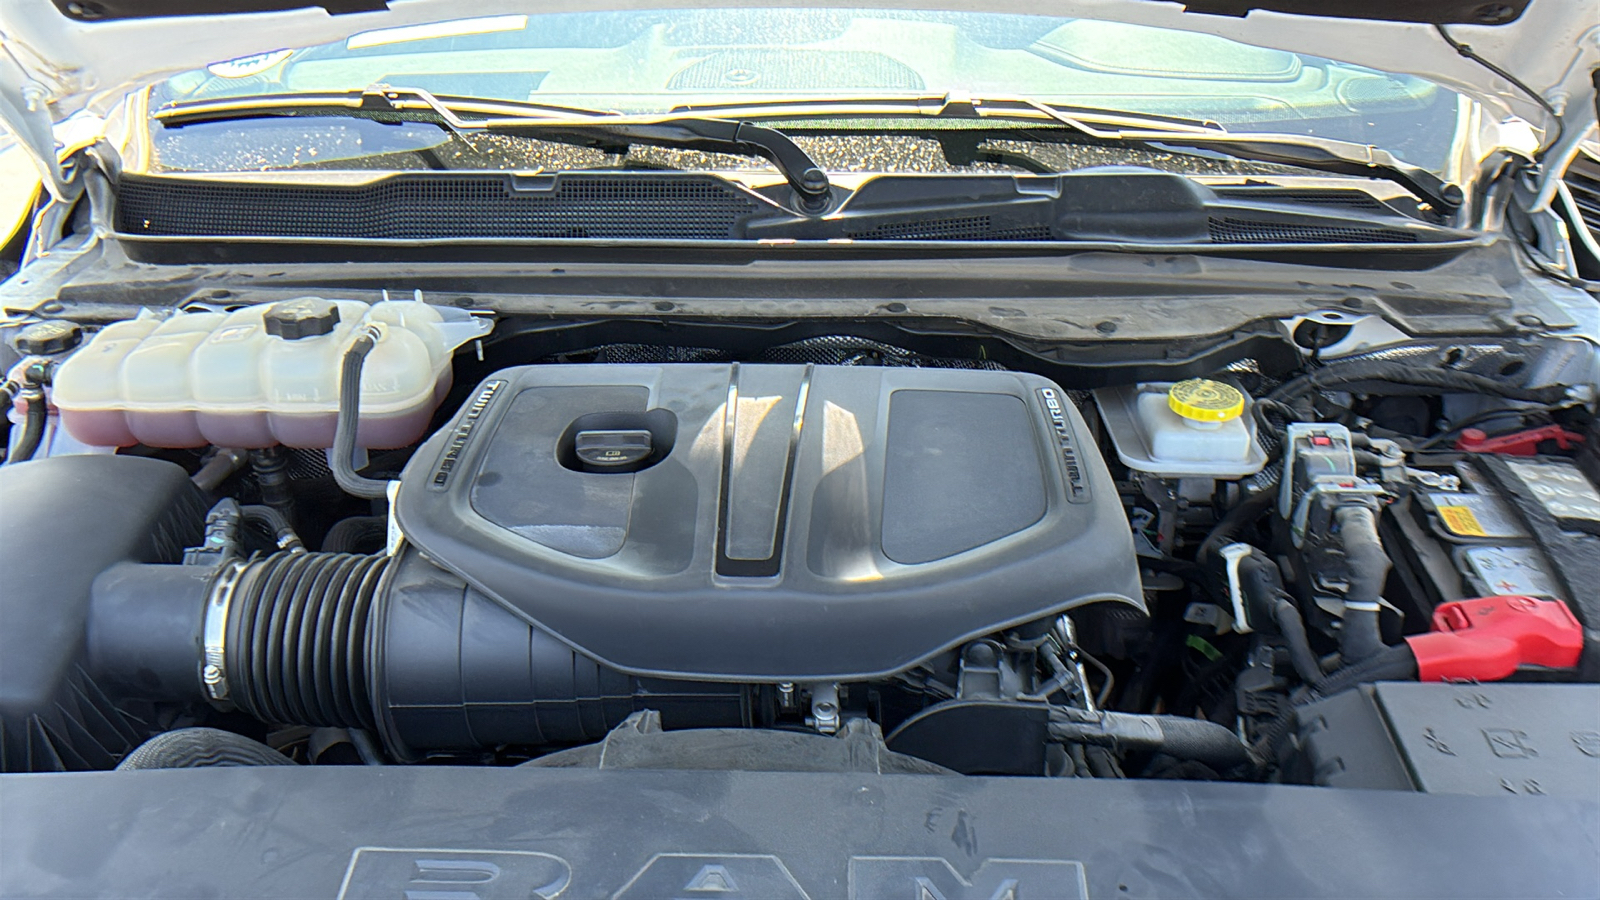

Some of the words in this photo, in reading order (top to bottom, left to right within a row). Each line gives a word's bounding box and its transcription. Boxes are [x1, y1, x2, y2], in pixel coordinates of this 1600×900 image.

[467, 380, 501, 420] TWIN
[1041, 387, 1070, 446] TURBO
[433, 421, 476, 487] TURBO
[1061, 447, 1084, 498] TWIN
